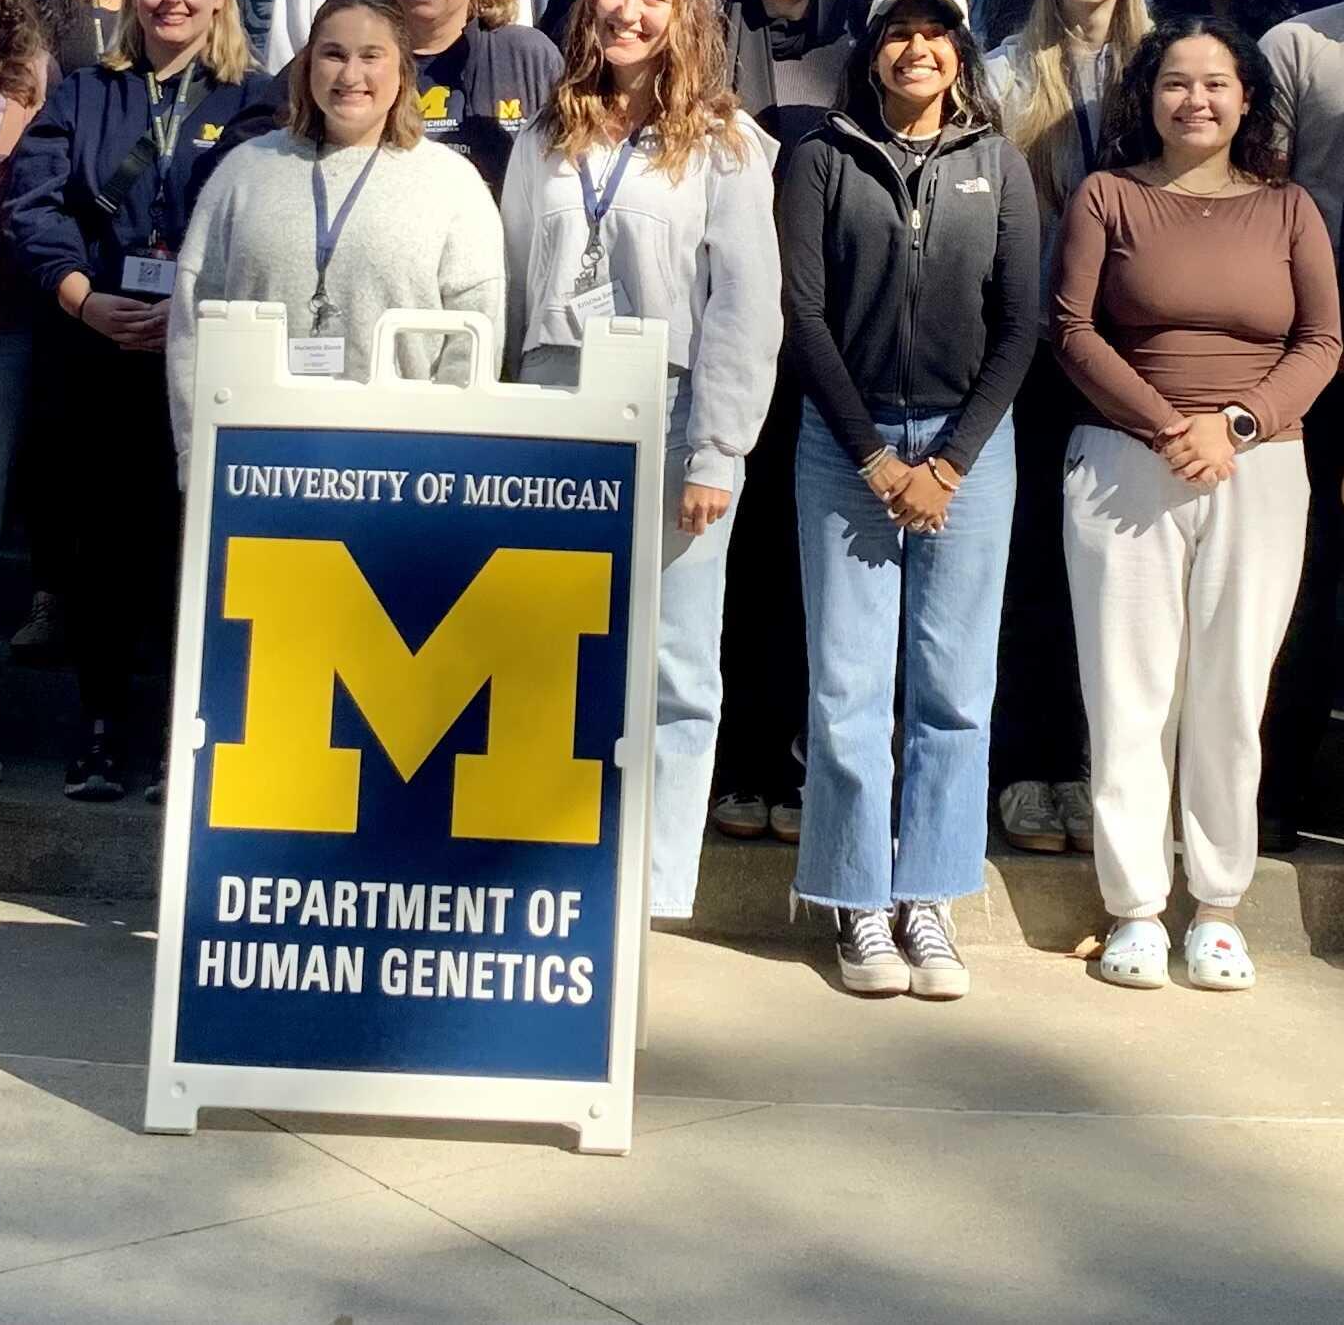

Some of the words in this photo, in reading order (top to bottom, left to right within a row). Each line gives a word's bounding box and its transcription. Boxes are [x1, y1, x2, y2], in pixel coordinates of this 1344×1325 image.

[499, 98, 523, 120] M
[227, 464, 409, 502] UNIVERSITY
[417, 472, 456, 504] OF
[463, 474, 623, 512] MICHIGAN
[209, 535, 613, 845] M
[217, 875, 514, 935] DEPARTMENT
[528, 888, 582, 938] OF
[197, 939, 366, 994] HUMAN
[381, 947, 594, 1005] GENETICS
